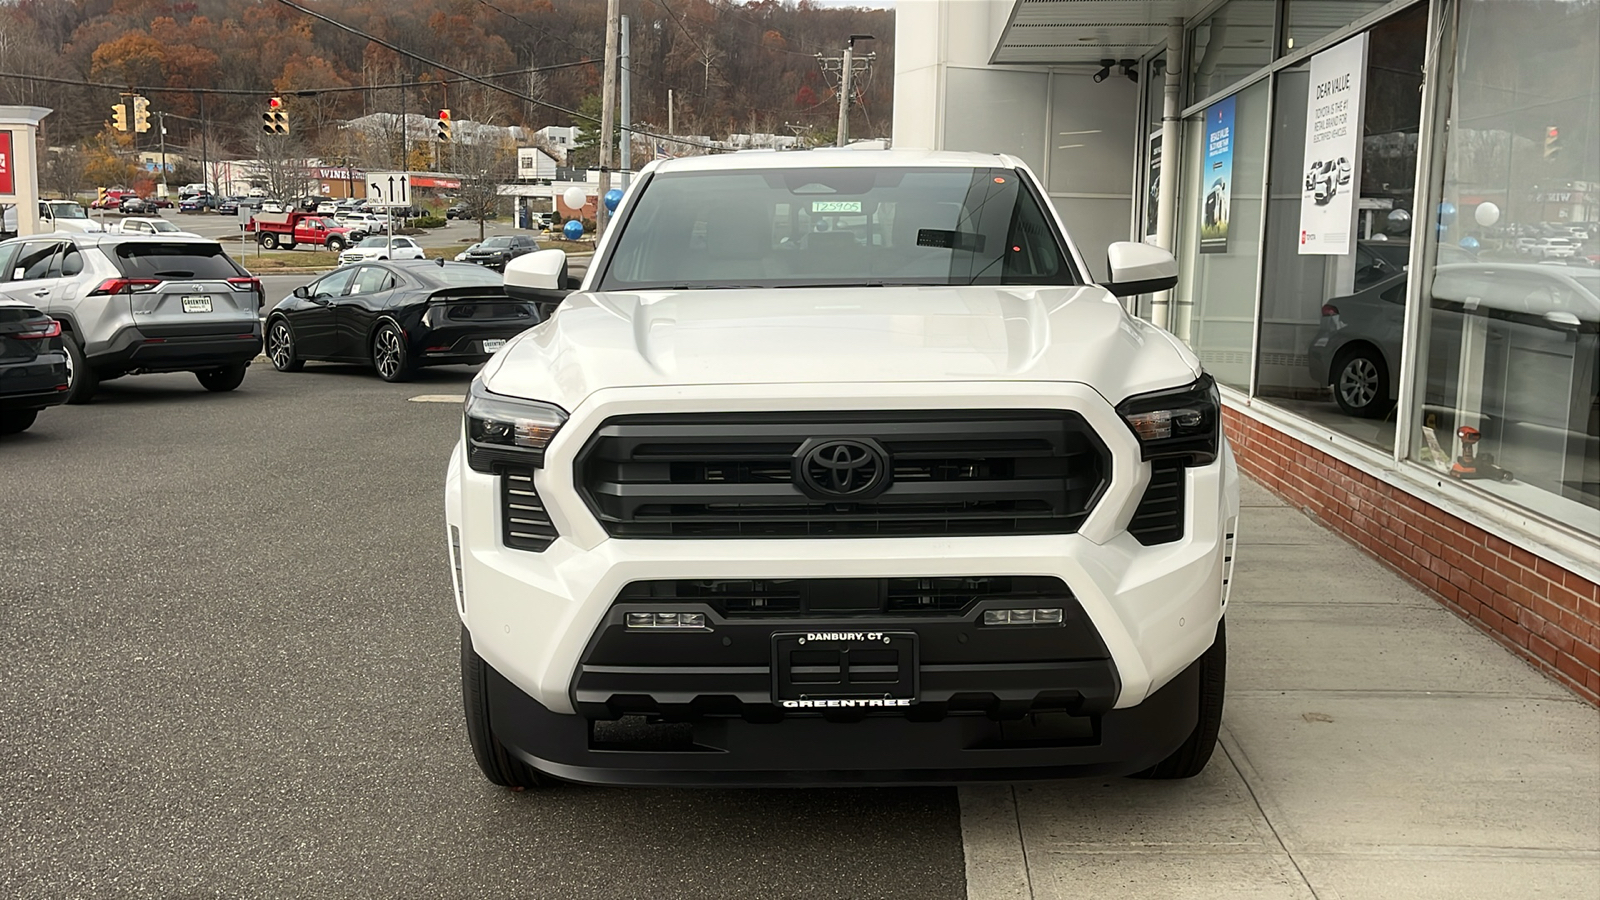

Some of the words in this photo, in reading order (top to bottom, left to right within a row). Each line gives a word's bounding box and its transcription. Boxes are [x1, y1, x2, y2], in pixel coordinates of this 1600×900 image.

[1317, 81, 1331, 100] DEAR
[1315, 105, 1330, 119] TOYOTA
[1335, 100, 1343, 113] THE
[1326, 115, 1339, 129] BRAND
[1339, 112, 1347, 124] FOR
[319, 168, 350, 181] WINES
[807, 632, 865, 642] DANBURY,
[867, 632, 883, 640] CT
[782, 699, 911, 708] GREENTREE
